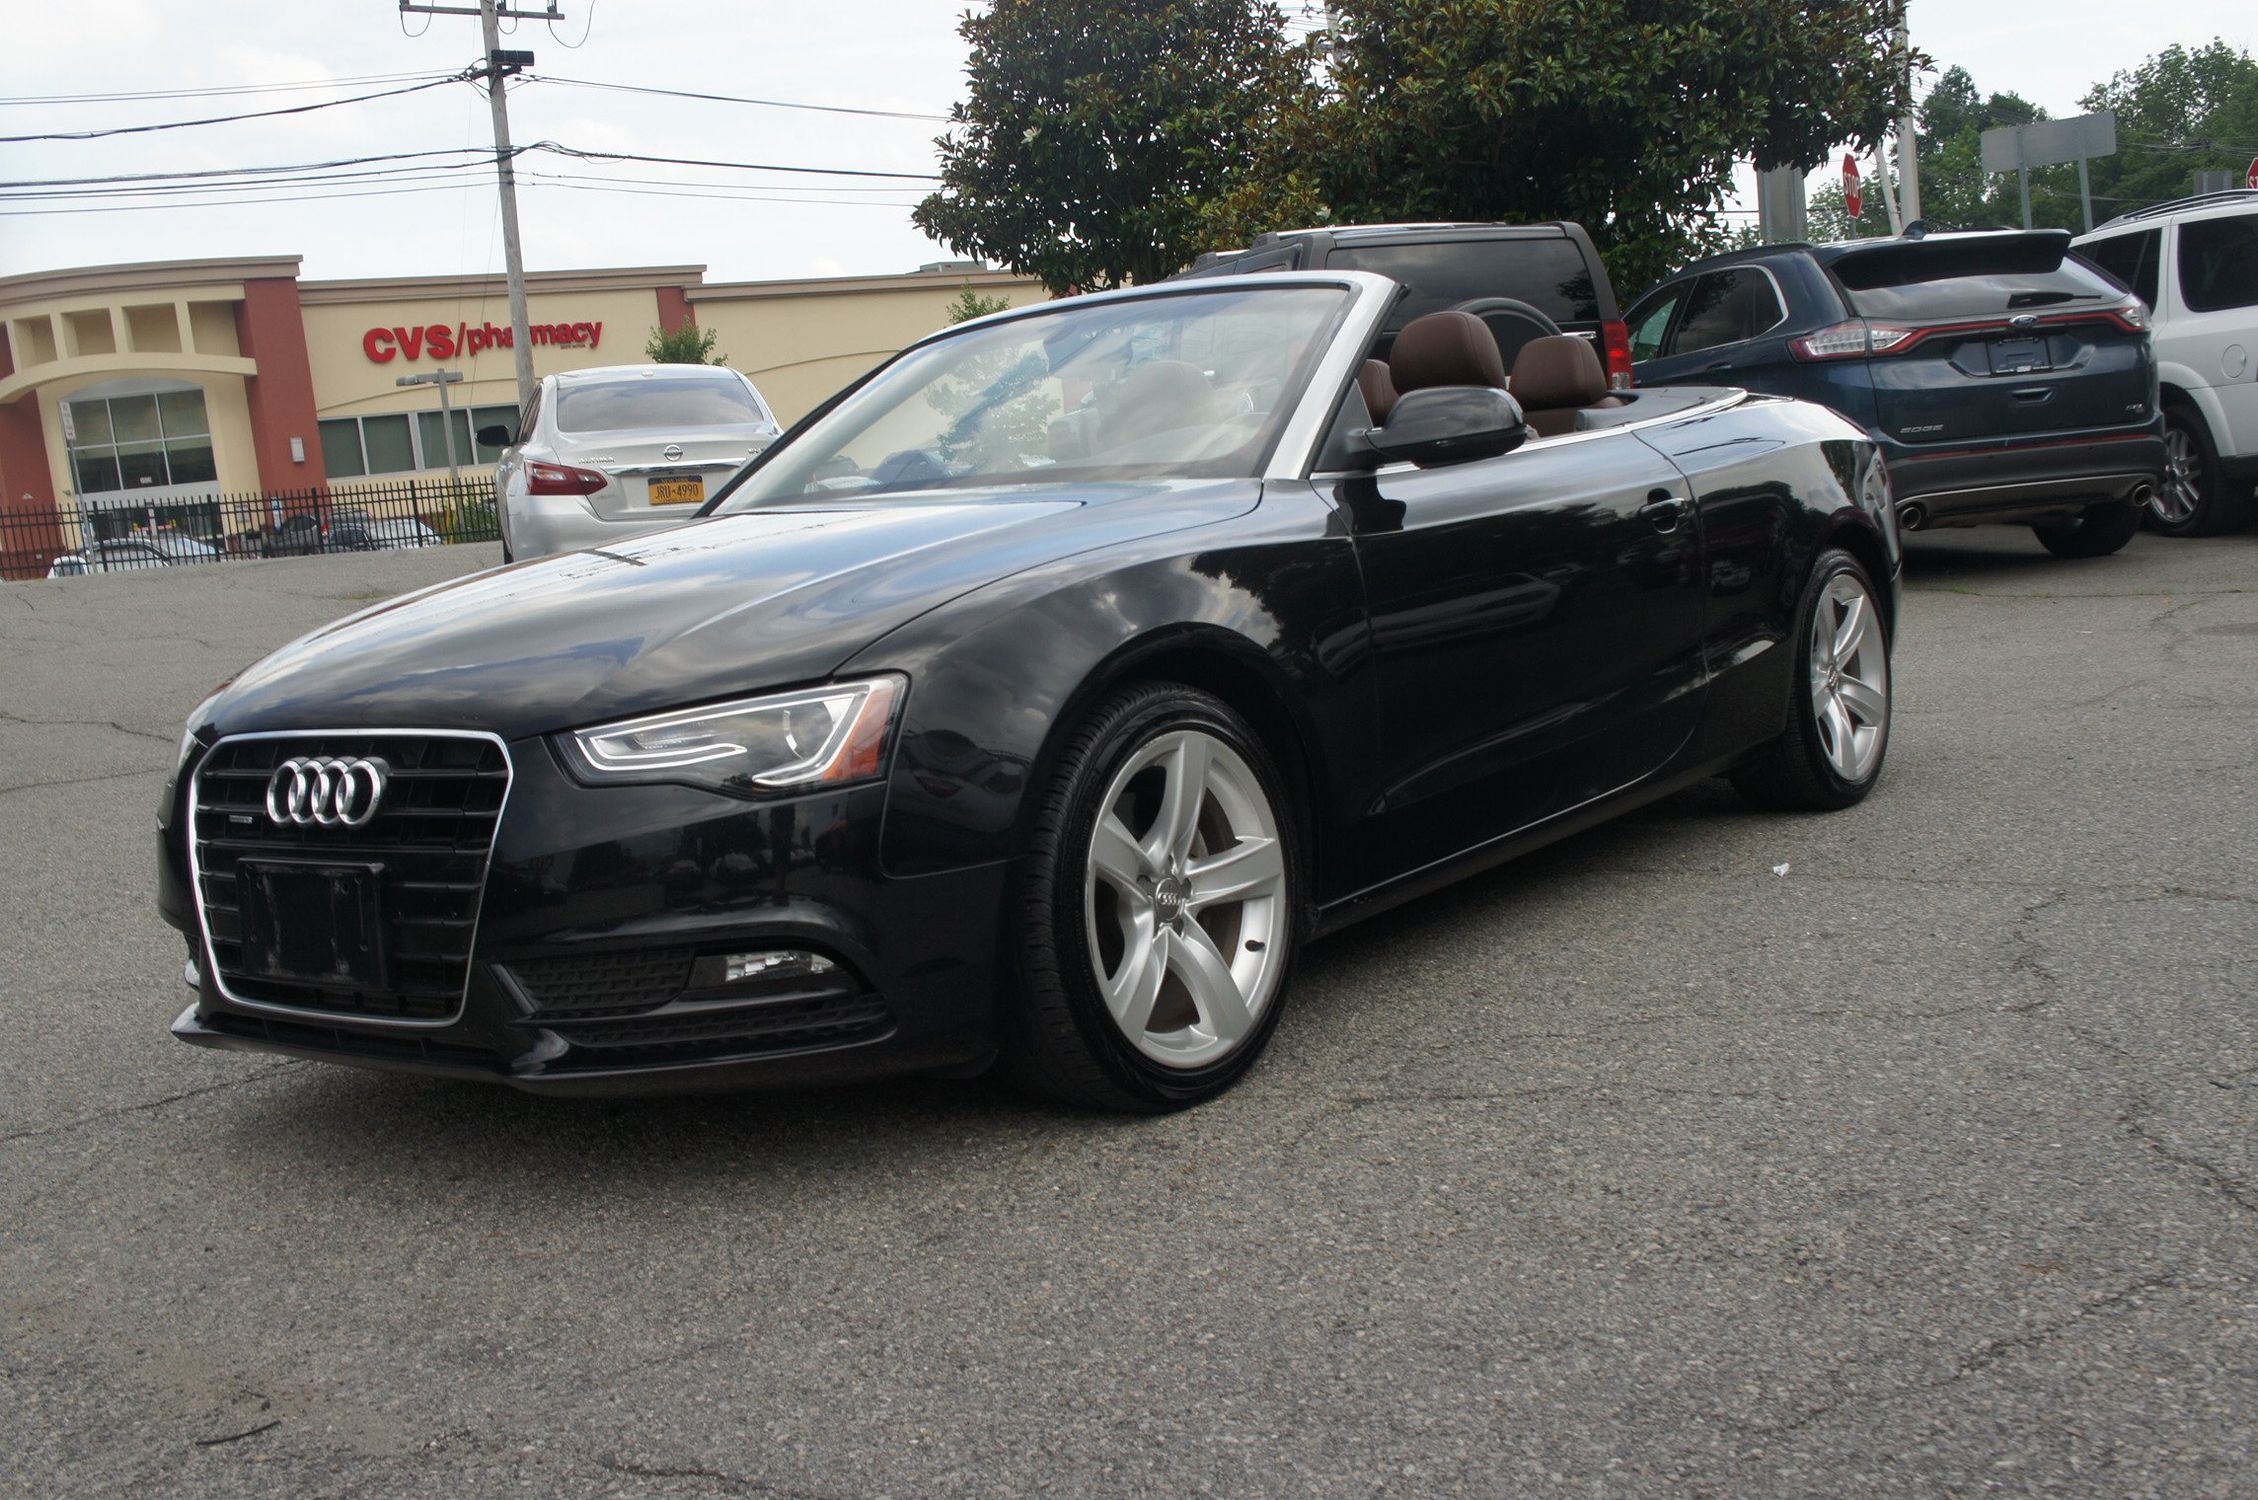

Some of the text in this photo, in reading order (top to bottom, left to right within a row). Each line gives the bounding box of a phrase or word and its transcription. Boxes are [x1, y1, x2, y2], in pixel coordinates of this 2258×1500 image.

[1843, 171, 1860, 199] STOP
[363, 321, 602, 364] CVS/phamacy
[1900, 424, 1944, 433] EDGE
